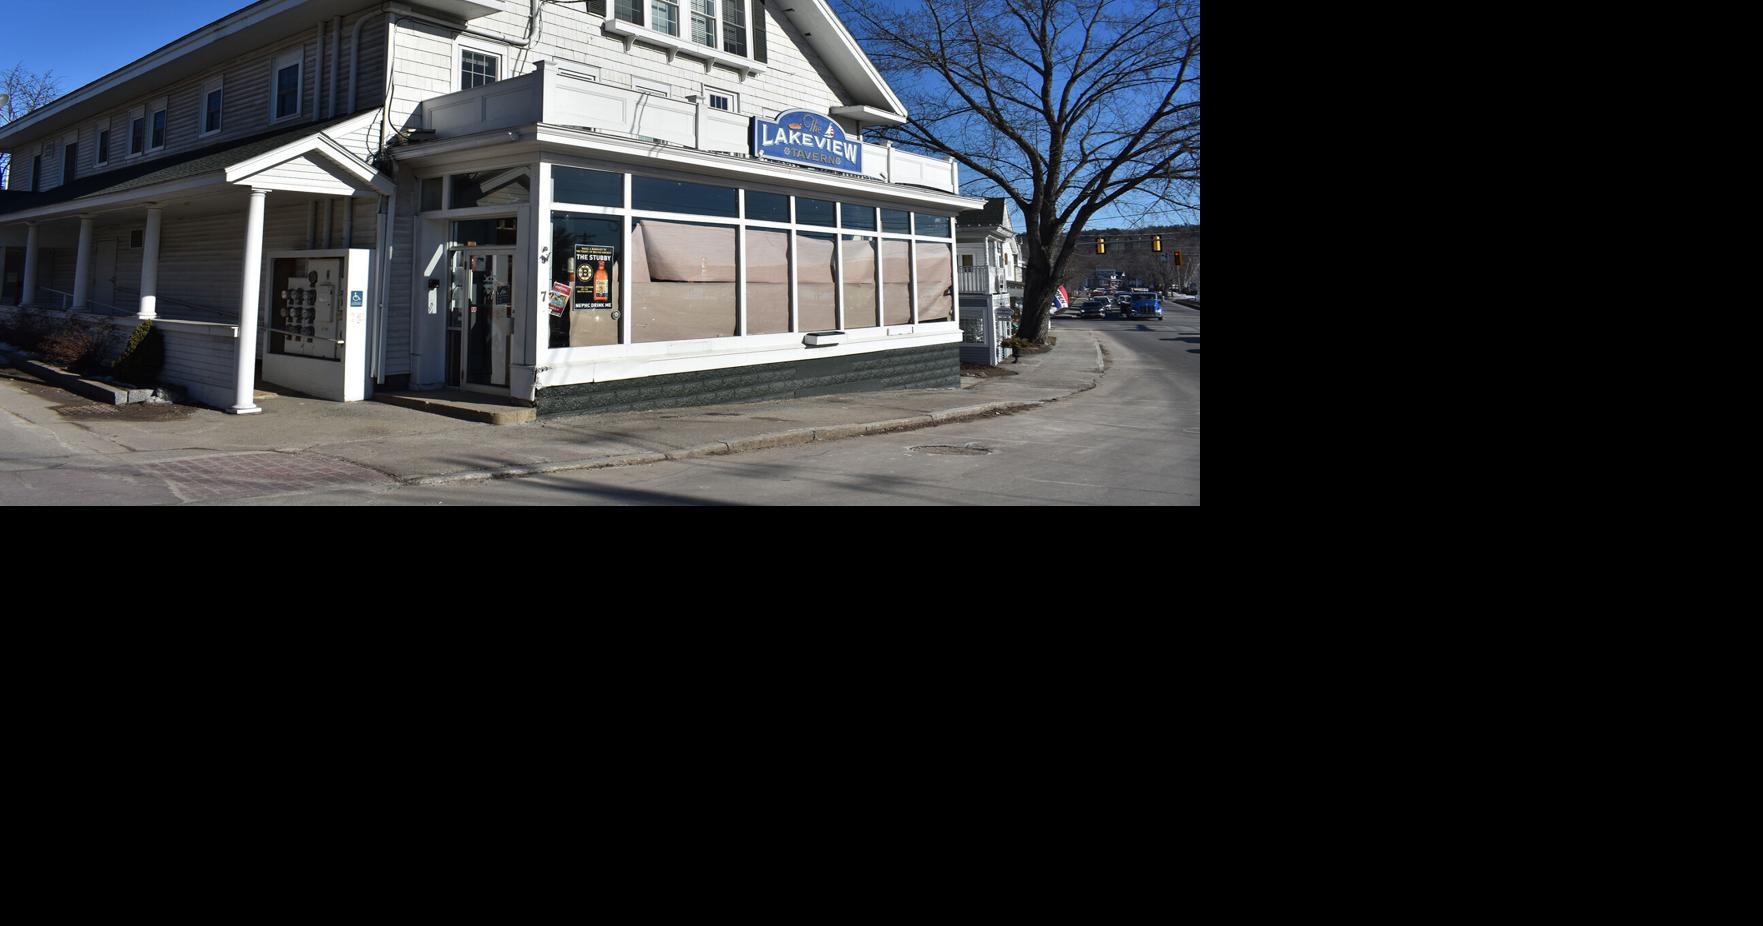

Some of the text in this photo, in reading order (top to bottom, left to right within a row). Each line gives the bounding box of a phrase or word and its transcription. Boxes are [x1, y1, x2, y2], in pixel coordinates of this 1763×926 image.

[802, 114, 821, 133] The
[762, 124, 857, 164] LAKEVIEW
[791, 148, 837, 165] TAVERN
[541, 291, 546, 302] 7
